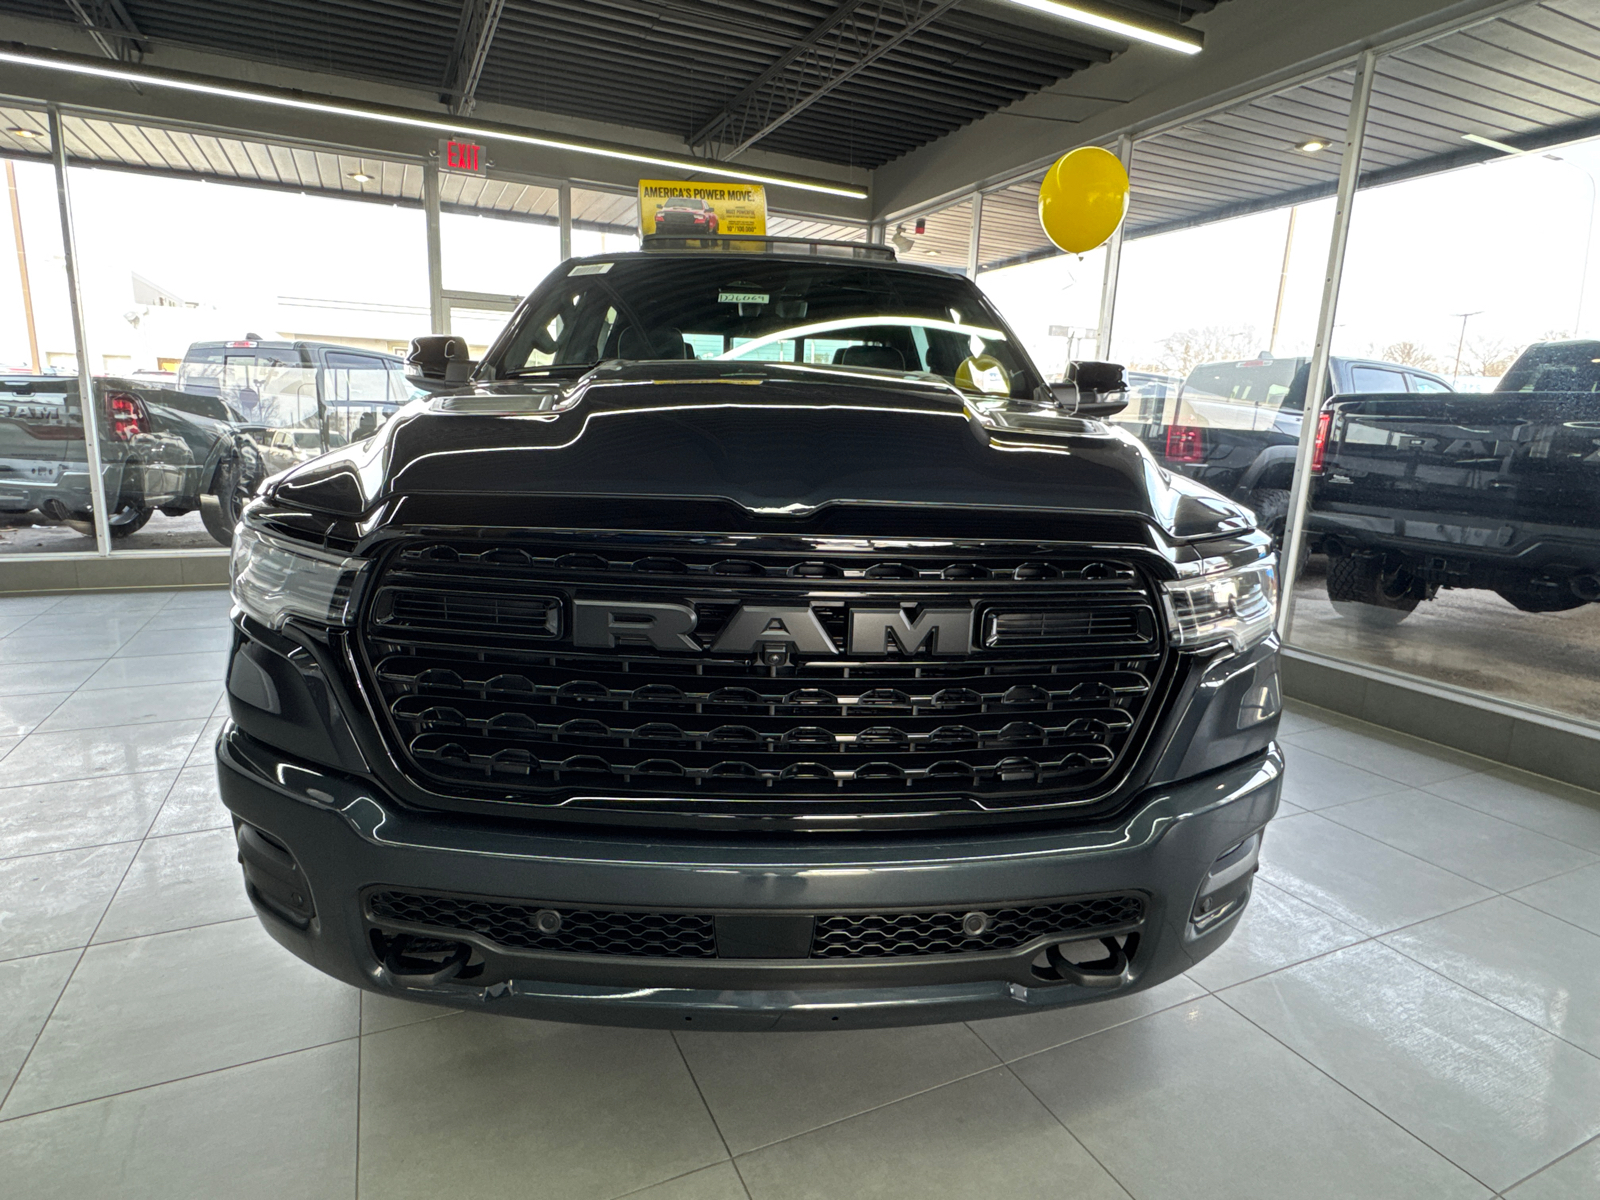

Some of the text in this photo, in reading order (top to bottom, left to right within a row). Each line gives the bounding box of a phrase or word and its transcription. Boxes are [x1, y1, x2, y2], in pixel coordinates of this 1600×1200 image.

[447, 141, 480, 171] EXIT
[644, 187, 755, 202] AMERICA'S POWER MOVE.
[0, 405, 59, 419] RAM
[1397, 436, 1549, 458] RAM
[573, 600, 974, 656] RAM
